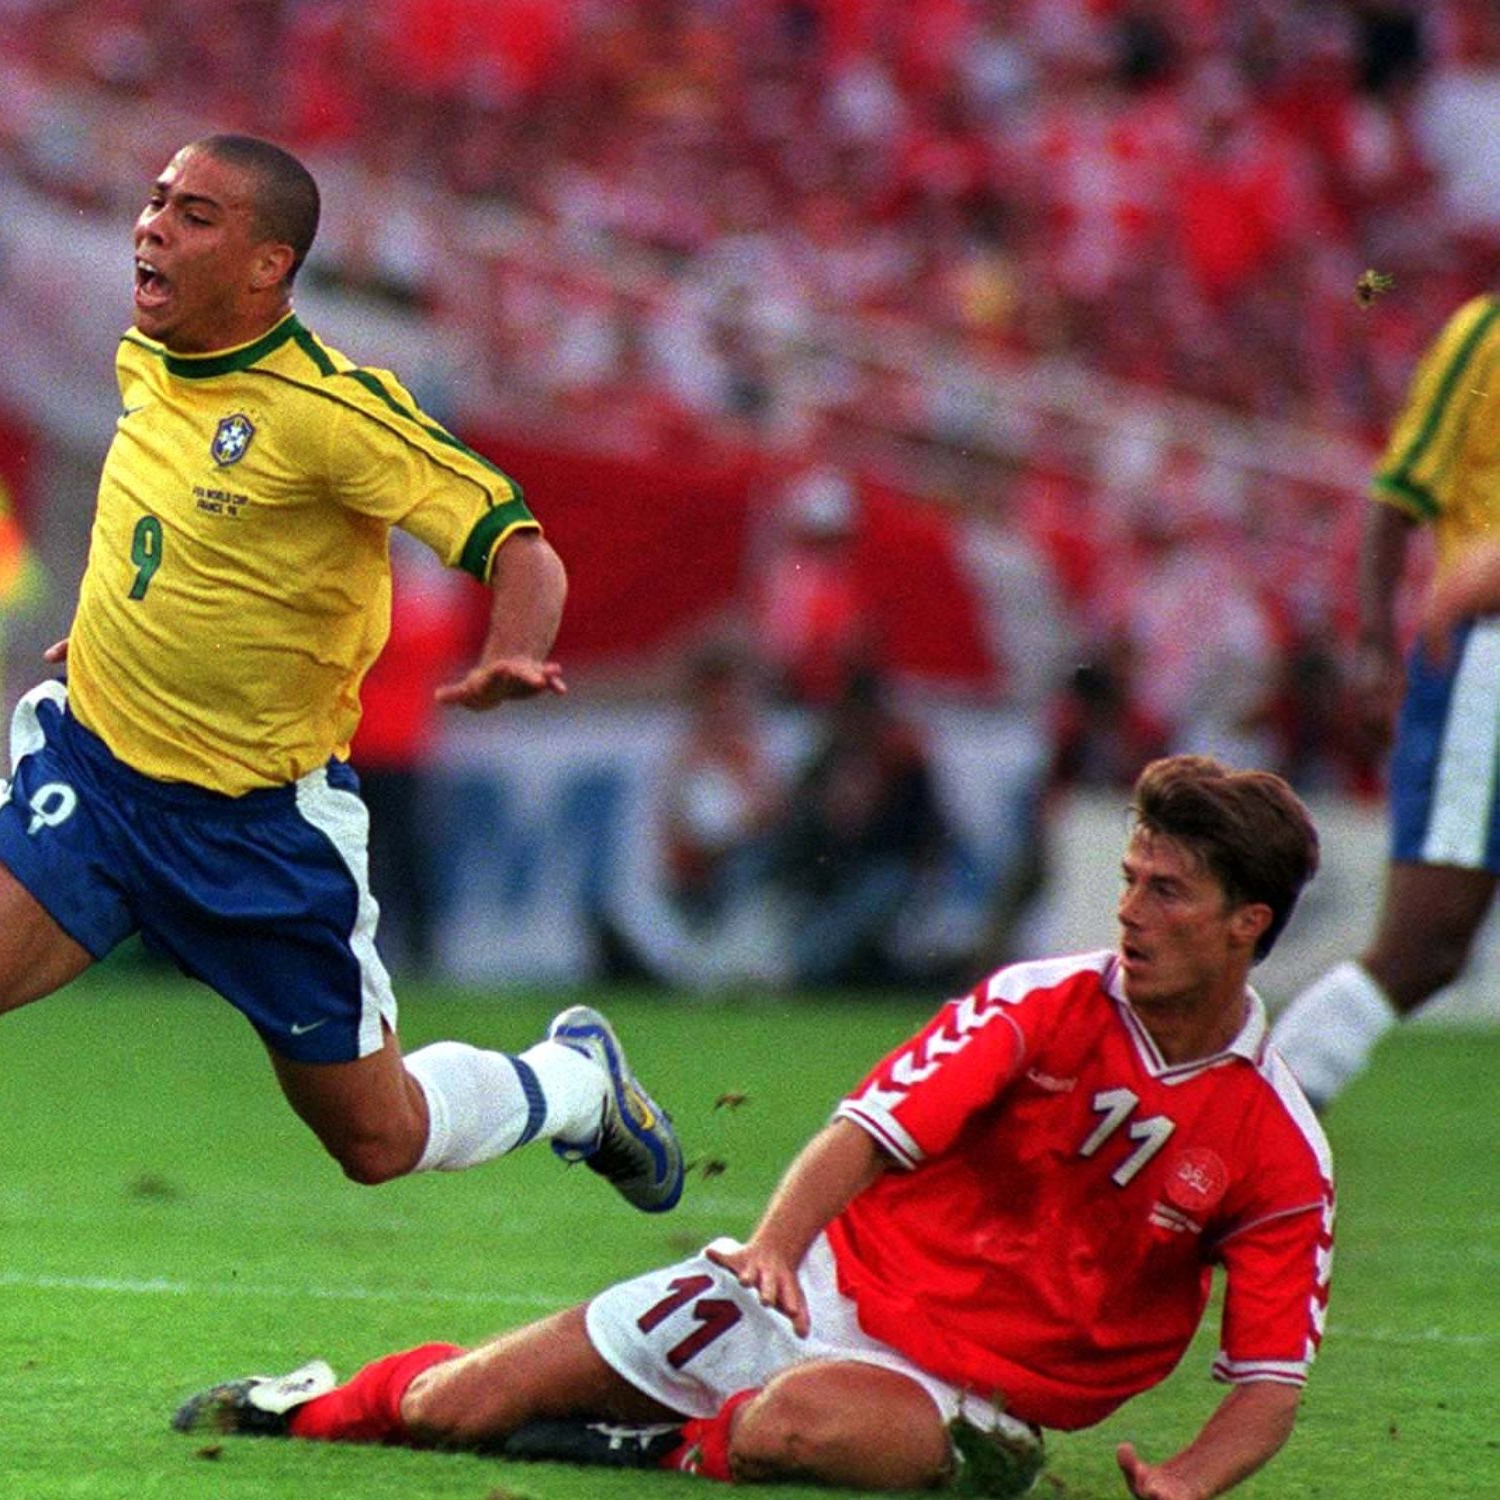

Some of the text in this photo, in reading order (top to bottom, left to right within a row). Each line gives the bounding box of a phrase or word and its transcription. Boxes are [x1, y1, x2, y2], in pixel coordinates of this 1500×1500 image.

[127, 514, 163, 601] 9
[27, 782, 77, 834] 9
[1078, 1086, 1177, 1188] 11
[637, 1273, 744, 1371] 11
